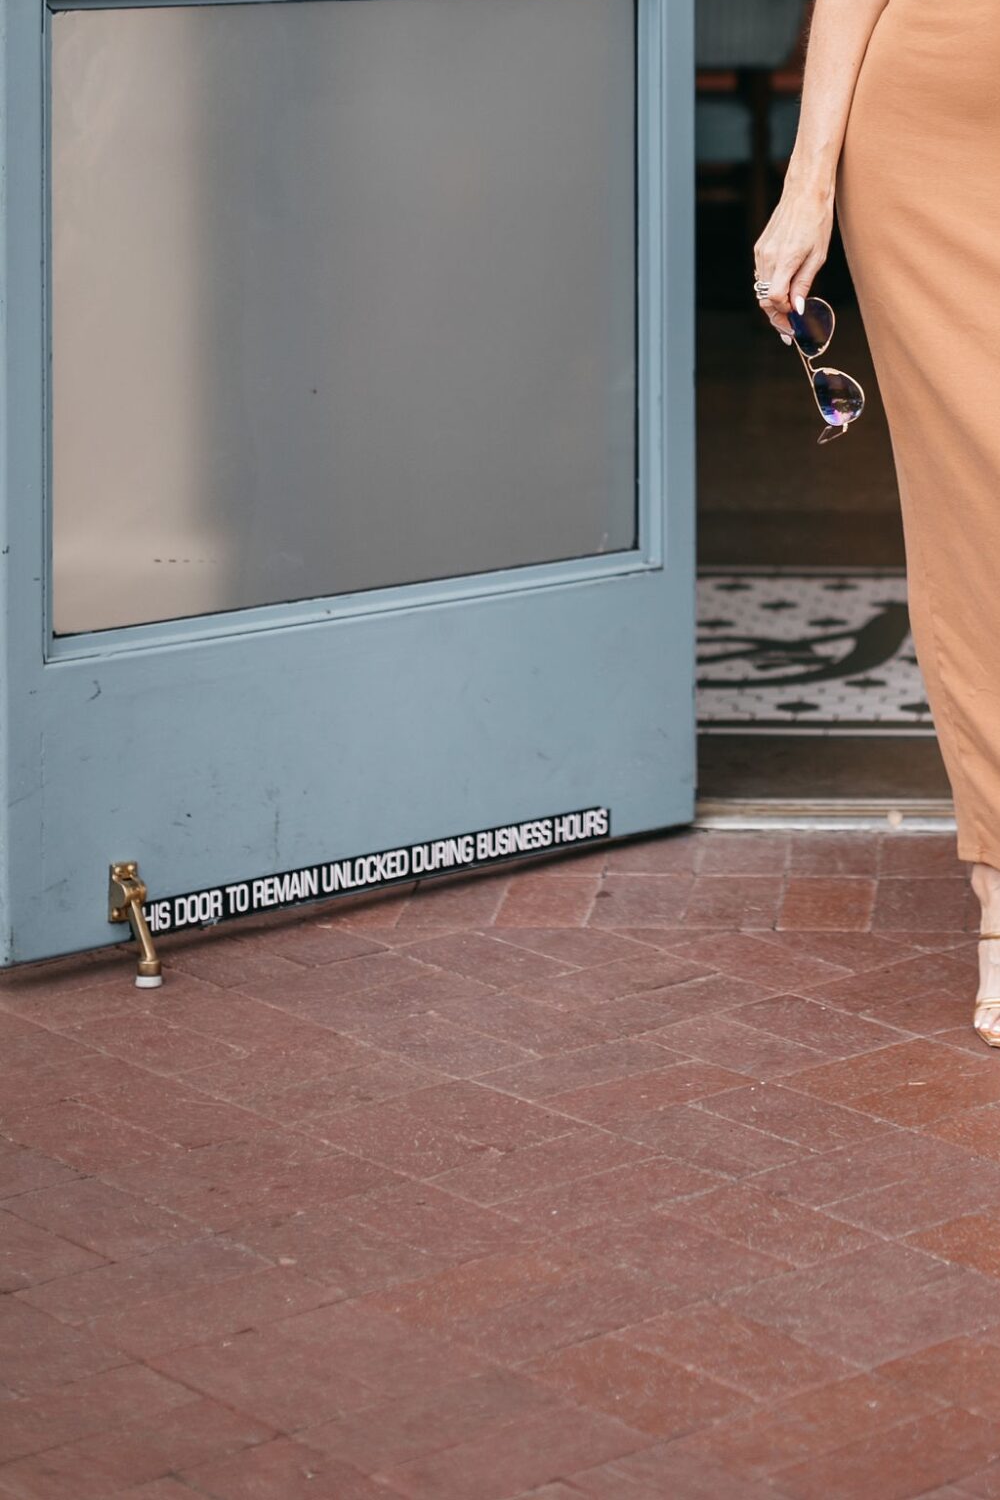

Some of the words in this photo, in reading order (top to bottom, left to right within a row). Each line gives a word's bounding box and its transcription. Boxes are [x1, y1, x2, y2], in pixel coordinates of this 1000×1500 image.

[142, 901, 171, 932] HIS
[175, 893, 223, 926] DOOR
[228, 884, 249, 914] TO
[253, 868, 318, 909] REMAIN
[322, 849, 409, 893] UNLOCKED
[412, 835, 474, 873] DURING
[477, 820, 552, 860] BUSINESS
[554, 808, 608, 843] HOURS
